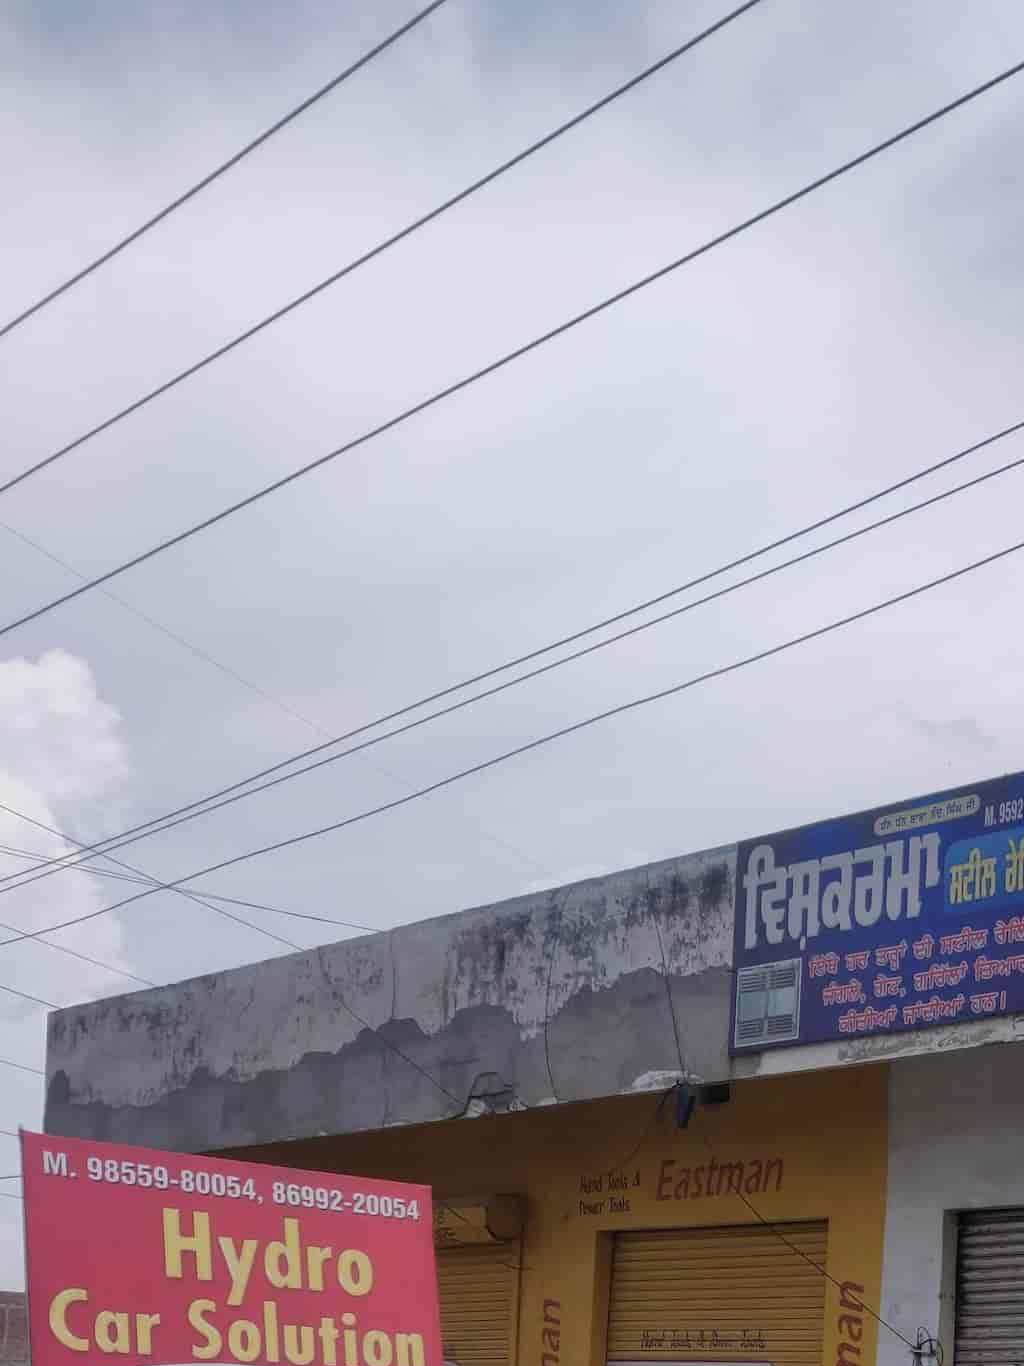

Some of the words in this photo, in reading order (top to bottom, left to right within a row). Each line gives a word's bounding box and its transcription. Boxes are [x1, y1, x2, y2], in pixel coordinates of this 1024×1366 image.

[984, 806, 997, 826] M.
[742, 831, 941, 951] ਵਿਸ਼ਕਰਮਾ
[950, 848, 997, 905] ਸਟੀਲ
[913, 933, 935, 961] ਦੀ
[42, 1151, 76, 1178] M.
[87, 1157, 264, 1204] 98559-80054,
[272, 1182, 420, 1220] 86992-20054
[656, 1154, 784, 1201] Eastman
[162, 1208, 374, 1306] Hydro
[48, 1289, 161, 1354] Car
